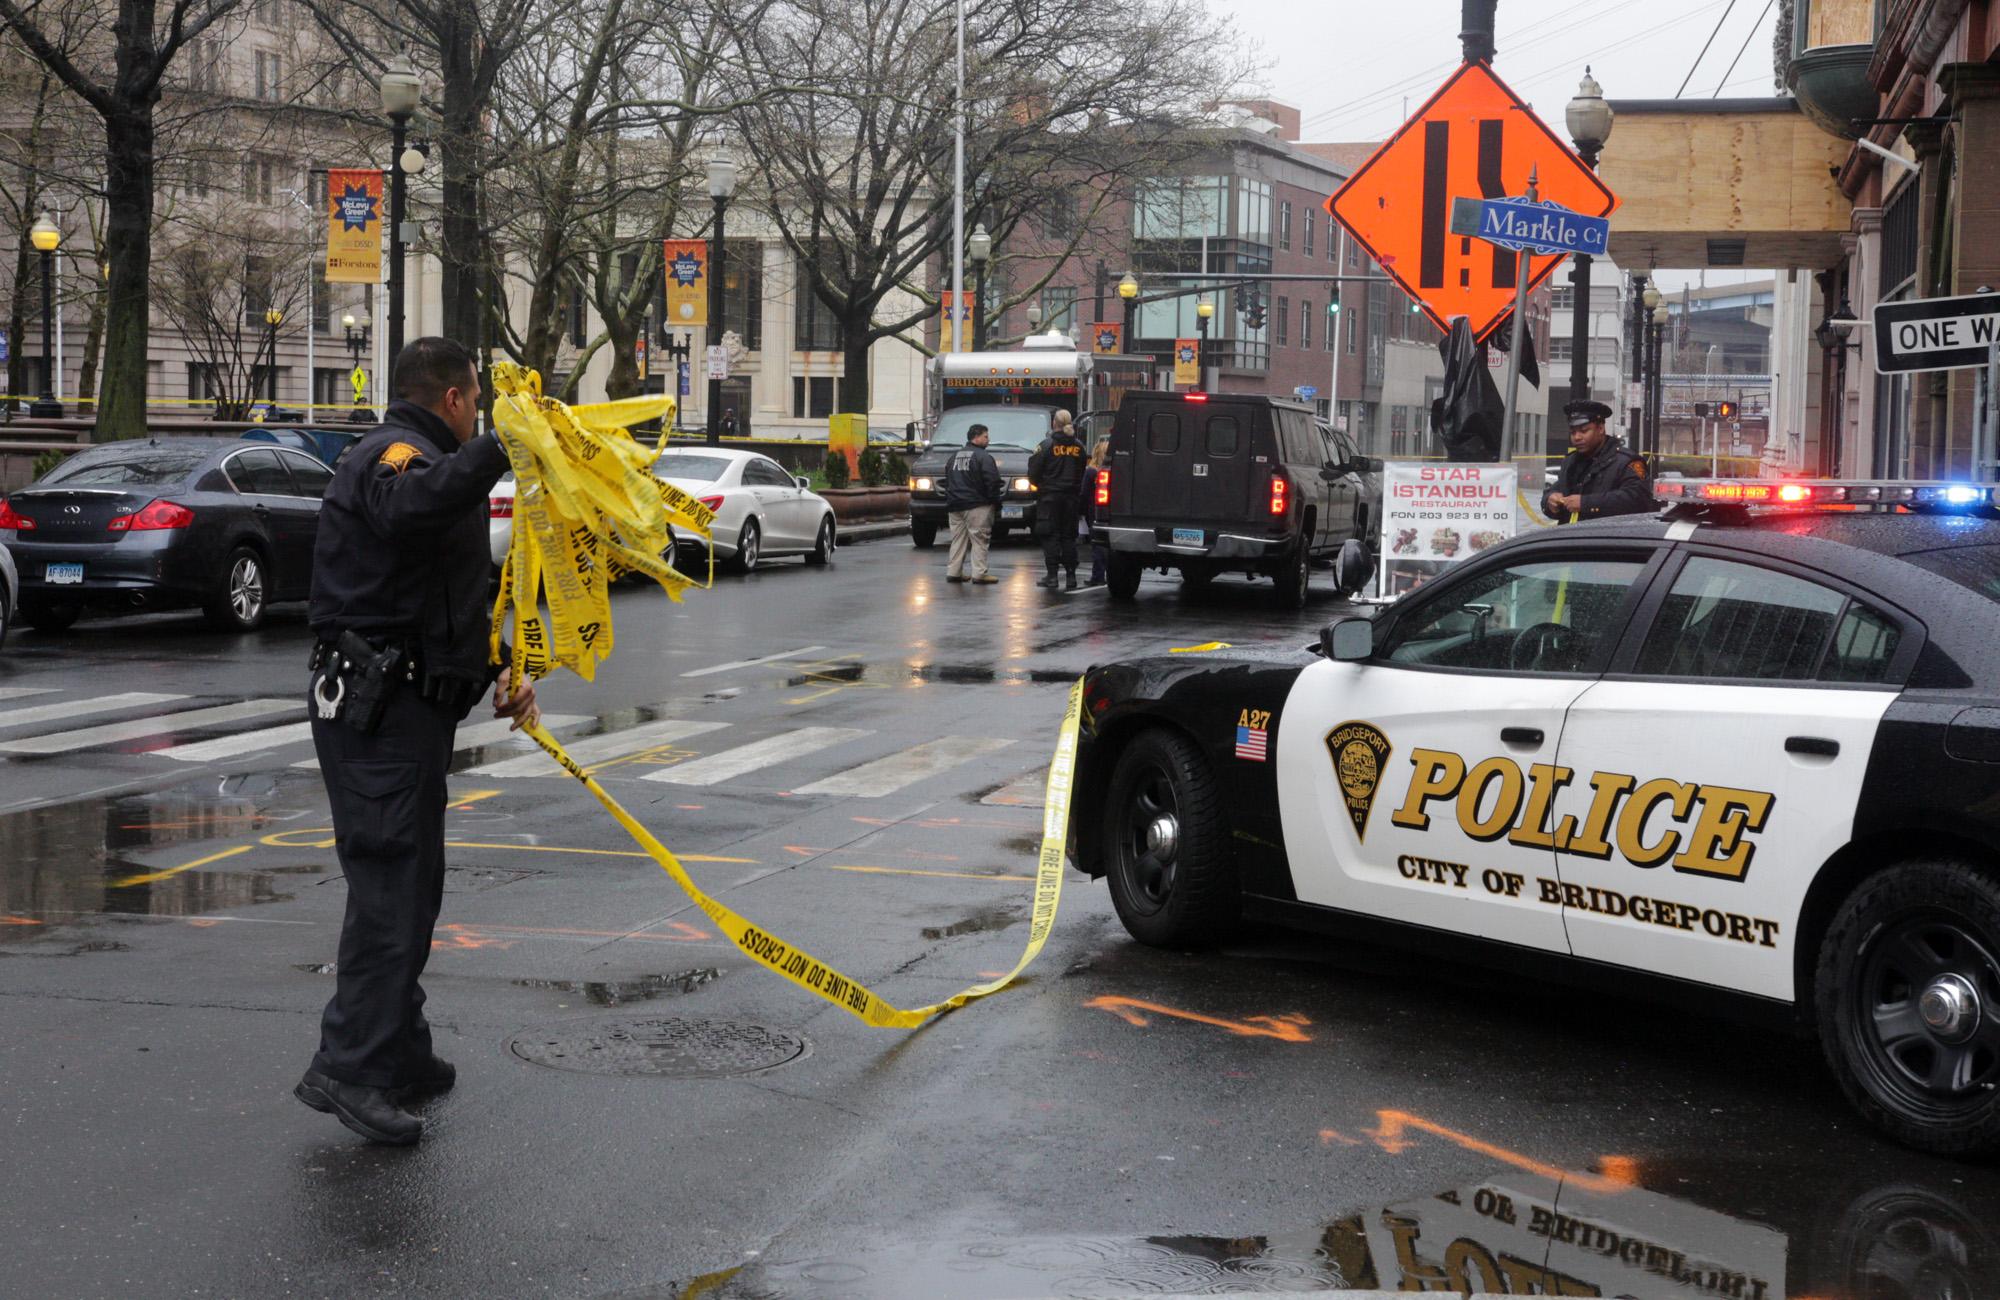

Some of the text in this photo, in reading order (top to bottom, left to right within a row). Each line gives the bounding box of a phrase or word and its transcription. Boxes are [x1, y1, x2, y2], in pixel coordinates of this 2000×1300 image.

[342, 200, 370, 211] McLevy
[344, 208, 367, 216] Green
[1484, 208, 1603, 246] Markle Ct
[1899, 317, 2000, 350] ONE W
[946, 377, 1076, 388] BRIDGEPORT POLICE
[1053, 445, 1080, 457] OCME
[1421, 468, 1481, 481] STAR
[1446, 512, 1470, 520] 923
[1493, 512, 1508, 520] 00
[1237, 708, 1271, 730] A27
[1331, 726, 1387, 754] BRIDGEPORT
[1347, 797, 1368, 810] POLICE
[1355, 812, 1362, 823] CT
[1391, 747, 1777, 883] POLICE
[1042, 847, 1060, 868] FIRE
[1040, 869, 1058, 889] LINE
[1038, 890, 1055, 903] DO
[1397, 854, 1780, 949] CITY OF BRIDGEPORT
[739, 928, 785, 965] CROSS
[781, 952, 810, 979] NOT
[806, 964, 826, 988] DO
[823, 973, 849, 1001] LINE
[847, 985, 869, 1014] FIRE
